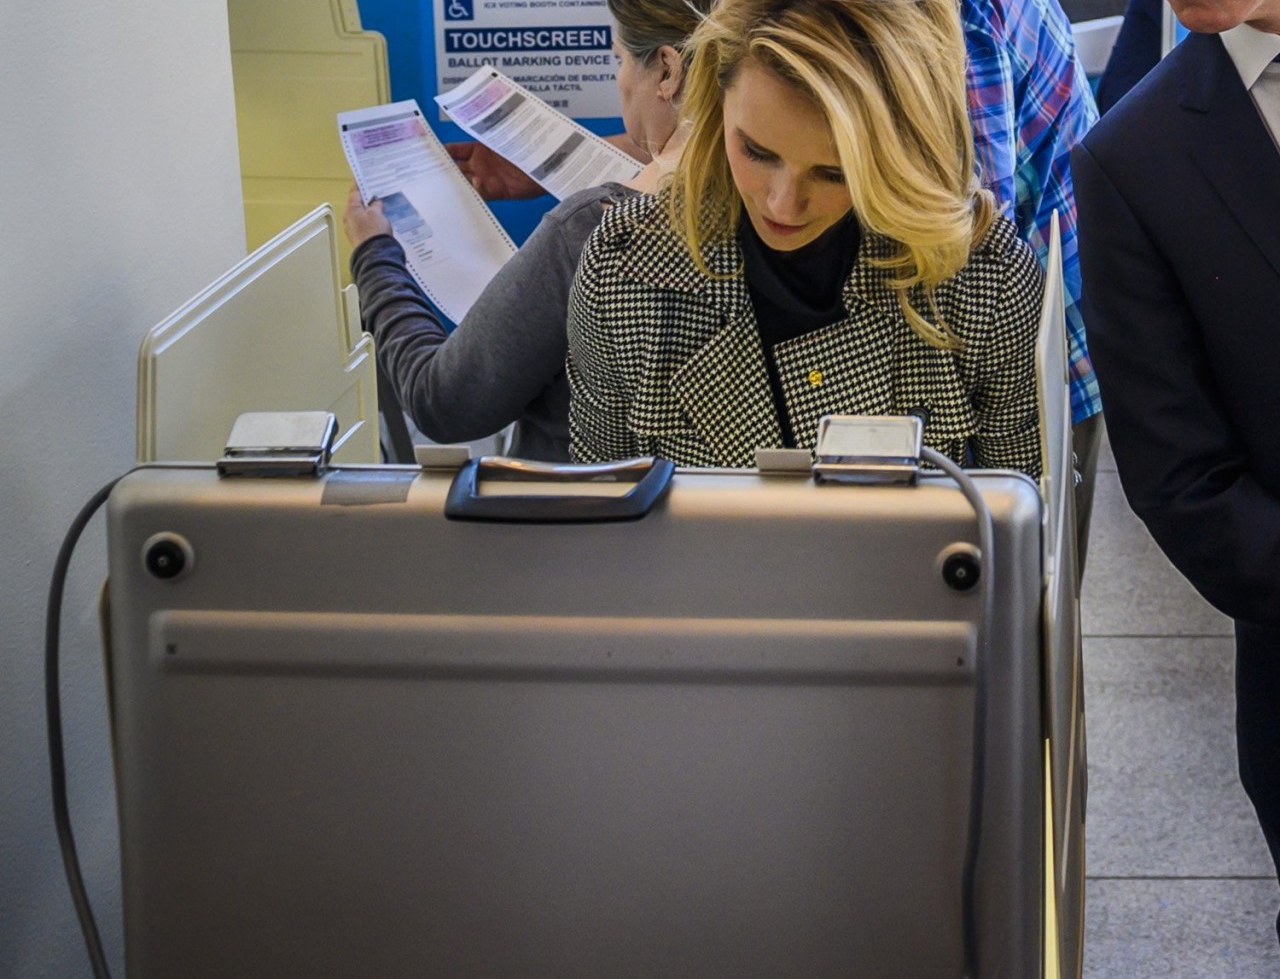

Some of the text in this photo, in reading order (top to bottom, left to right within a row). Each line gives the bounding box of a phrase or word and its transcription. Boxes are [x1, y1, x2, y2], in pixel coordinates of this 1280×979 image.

[450, 30, 607, 49] TOUCHSCREEN
[502, 56, 561, 67] MARKING
[565, 55, 611, 66] DEVICE
[568, 74, 579, 82] DE
[582, 74, 617, 82] BOLETA
